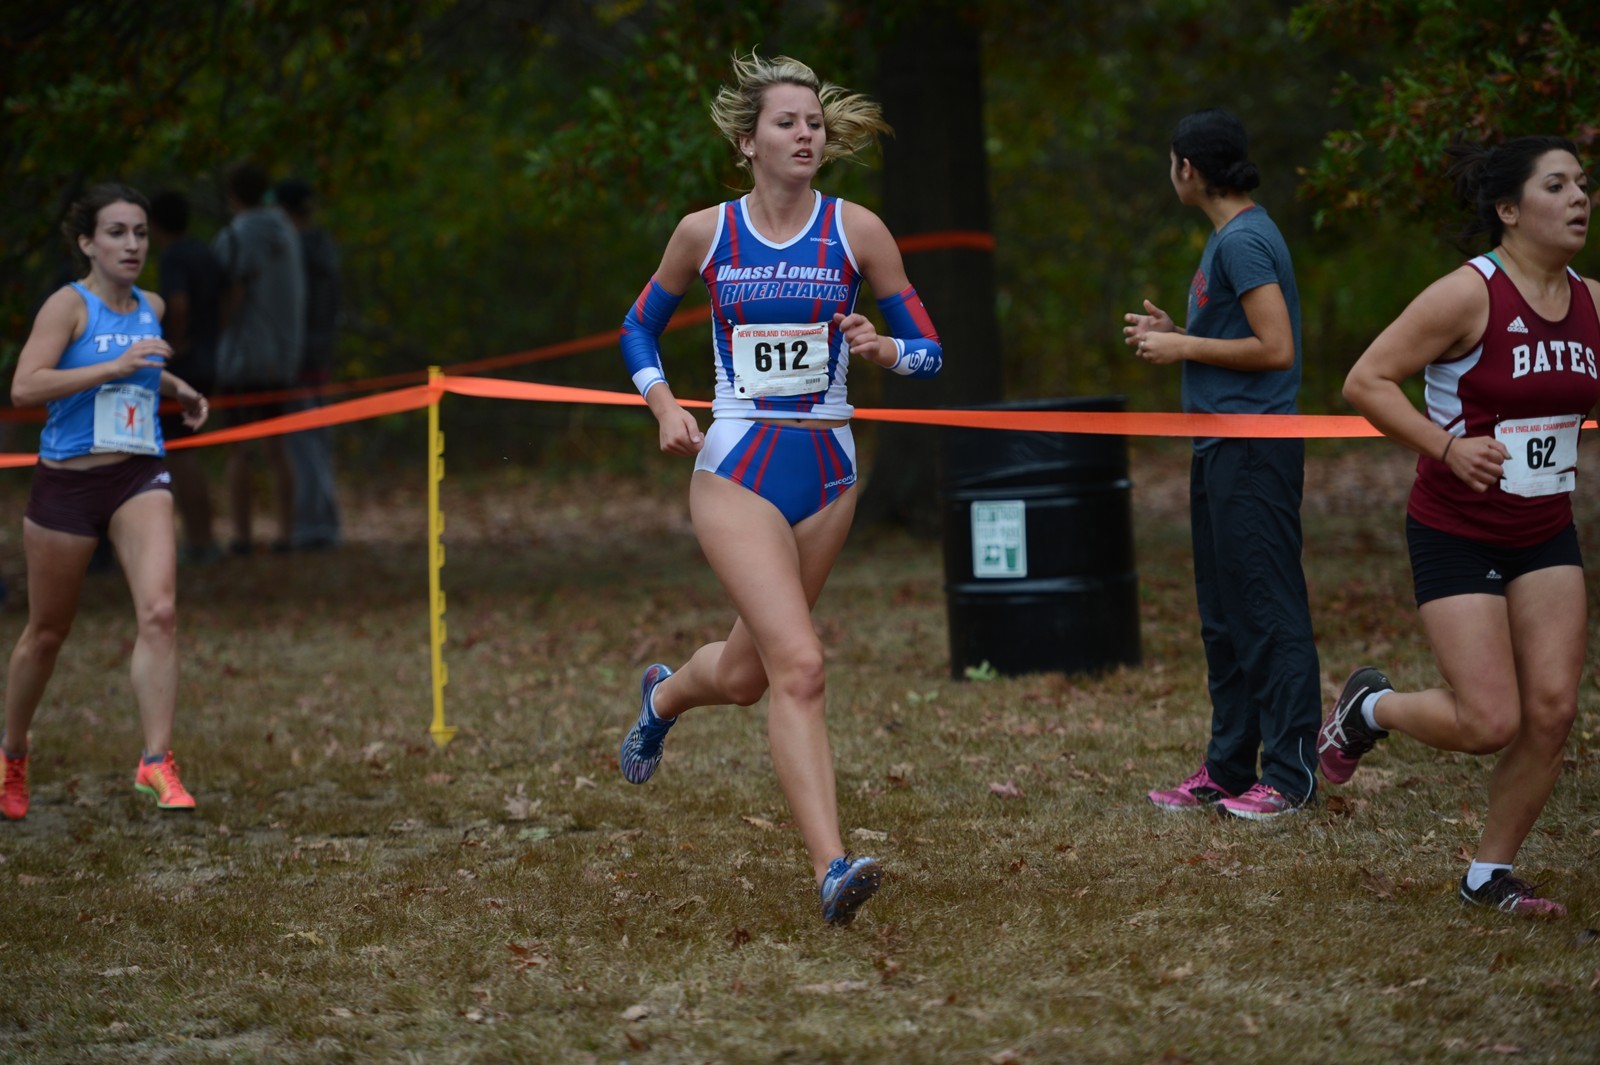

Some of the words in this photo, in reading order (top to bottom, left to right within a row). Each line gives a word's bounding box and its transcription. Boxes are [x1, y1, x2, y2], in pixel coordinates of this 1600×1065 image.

[775, 261, 841, 282] LOWELL
[720, 282, 780, 307] RIVER
[780, 282, 849, 302] HAWKS
[94, 333, 162, 353] TUF
[753, 330, 779, 338] ENGLAND
[754, 340, 810, 373] 612
[1512, 340, 1598, 380] BATES
[1500, 426, 1514, 435] NEW
[1515, 424, 1542, 434] ENGLAND
[1526, 435, 1557, 470] 62
